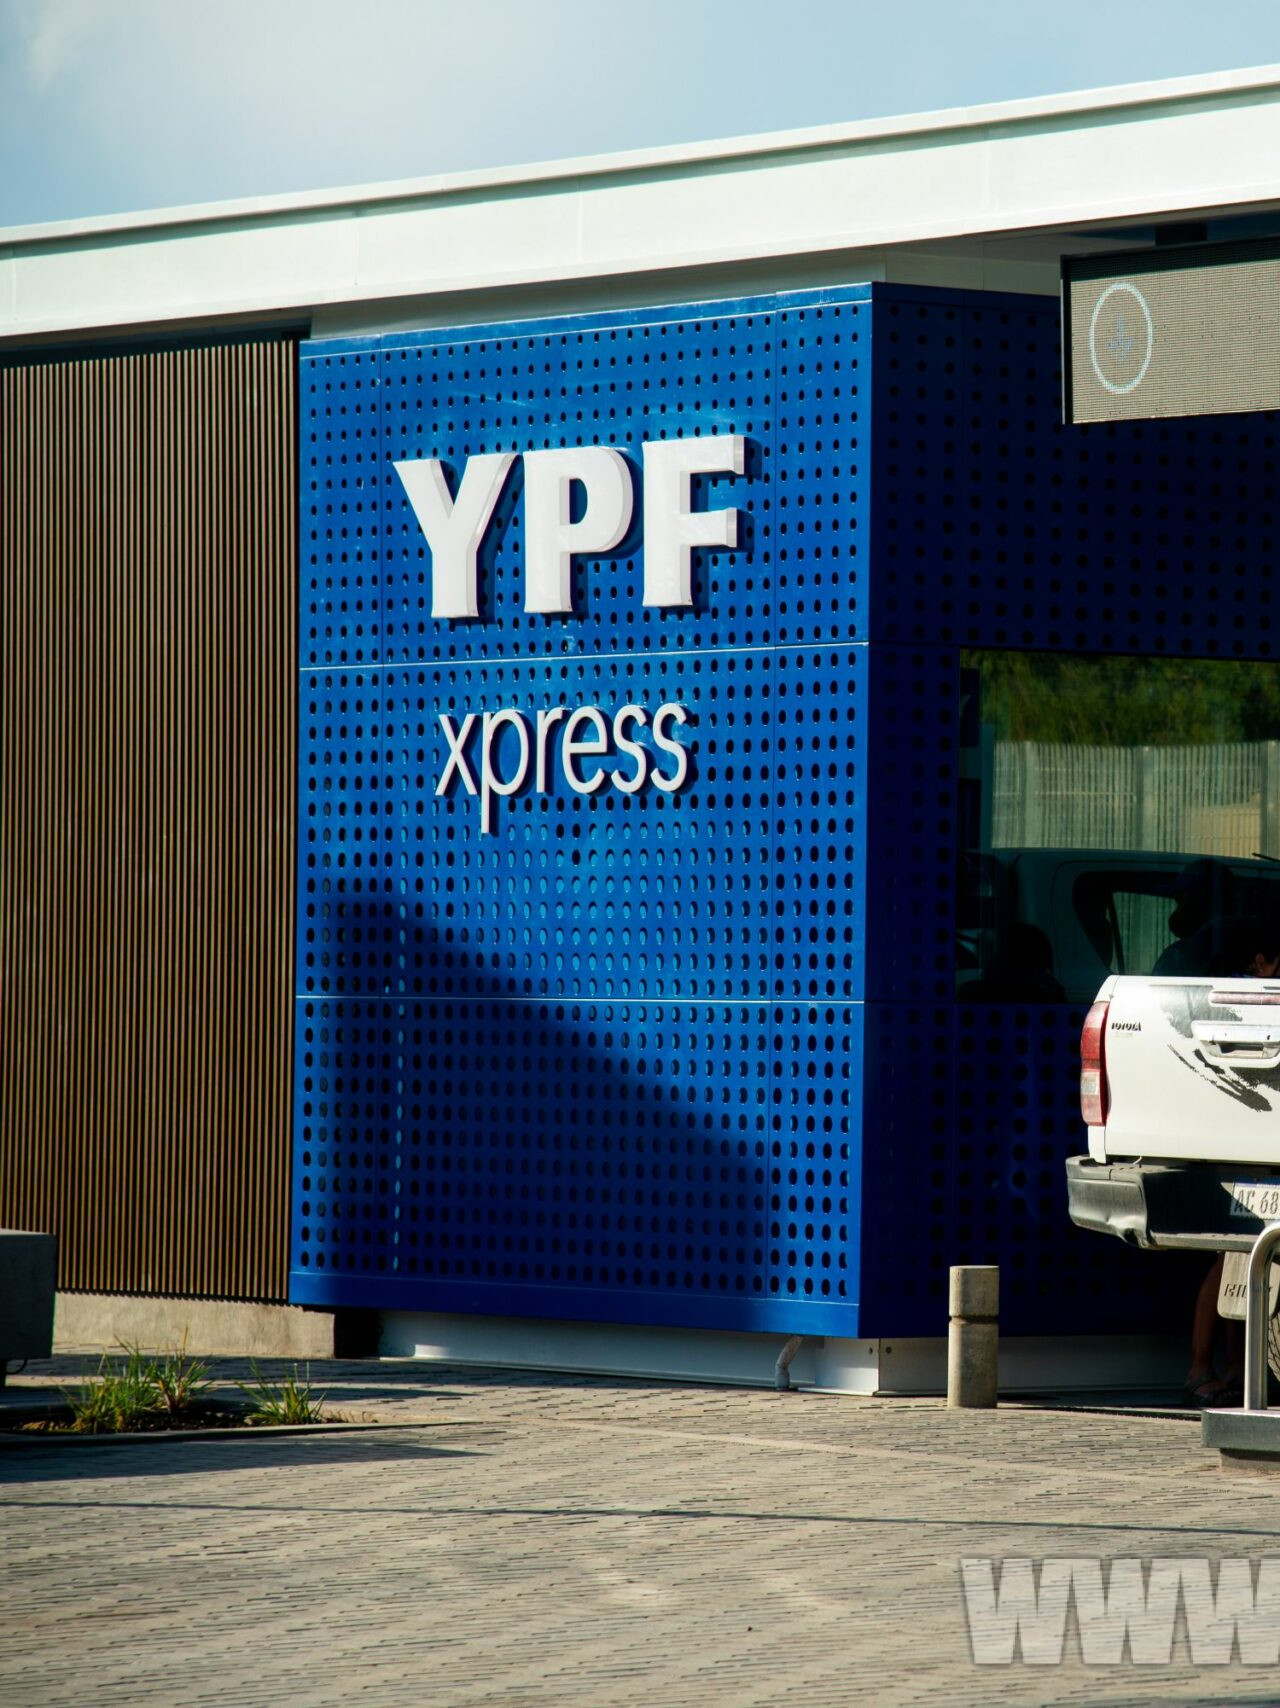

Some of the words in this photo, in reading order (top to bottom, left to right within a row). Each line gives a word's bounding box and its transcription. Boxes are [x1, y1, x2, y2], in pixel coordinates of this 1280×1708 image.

[393, 434, 746, 619] YPF
[434, 702, 691, 834] xpress
[1234, 1189, 1256, 1213] AC
